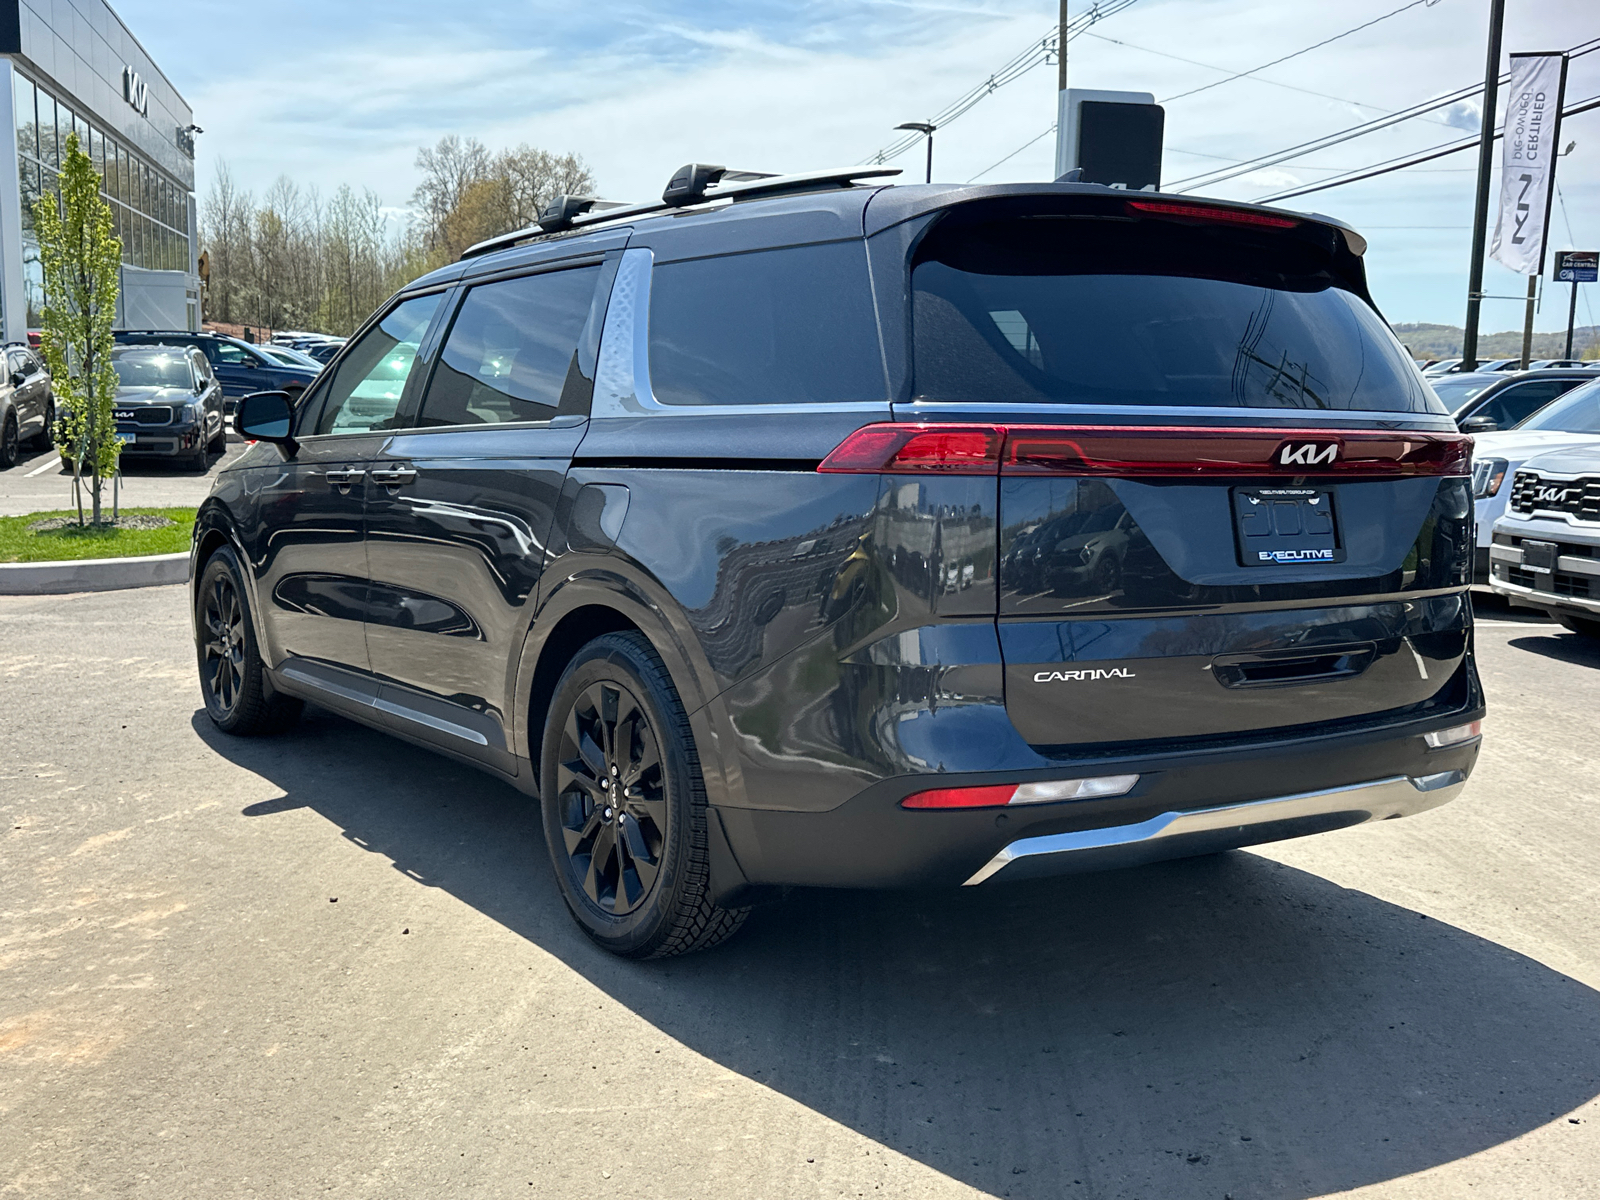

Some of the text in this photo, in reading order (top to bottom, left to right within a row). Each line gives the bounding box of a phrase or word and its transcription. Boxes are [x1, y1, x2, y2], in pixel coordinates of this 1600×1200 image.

[122, 65, 148, 118] KIA
[115, 406, 135, 418] KIA
[1280, 443, 1339, 465] KIA
[1539, 486, 1567, 502] KIA
[1258, 549, 1334, 562] EXECUTIVE
[1033, 667, 1137, 683] CARNIVAL
